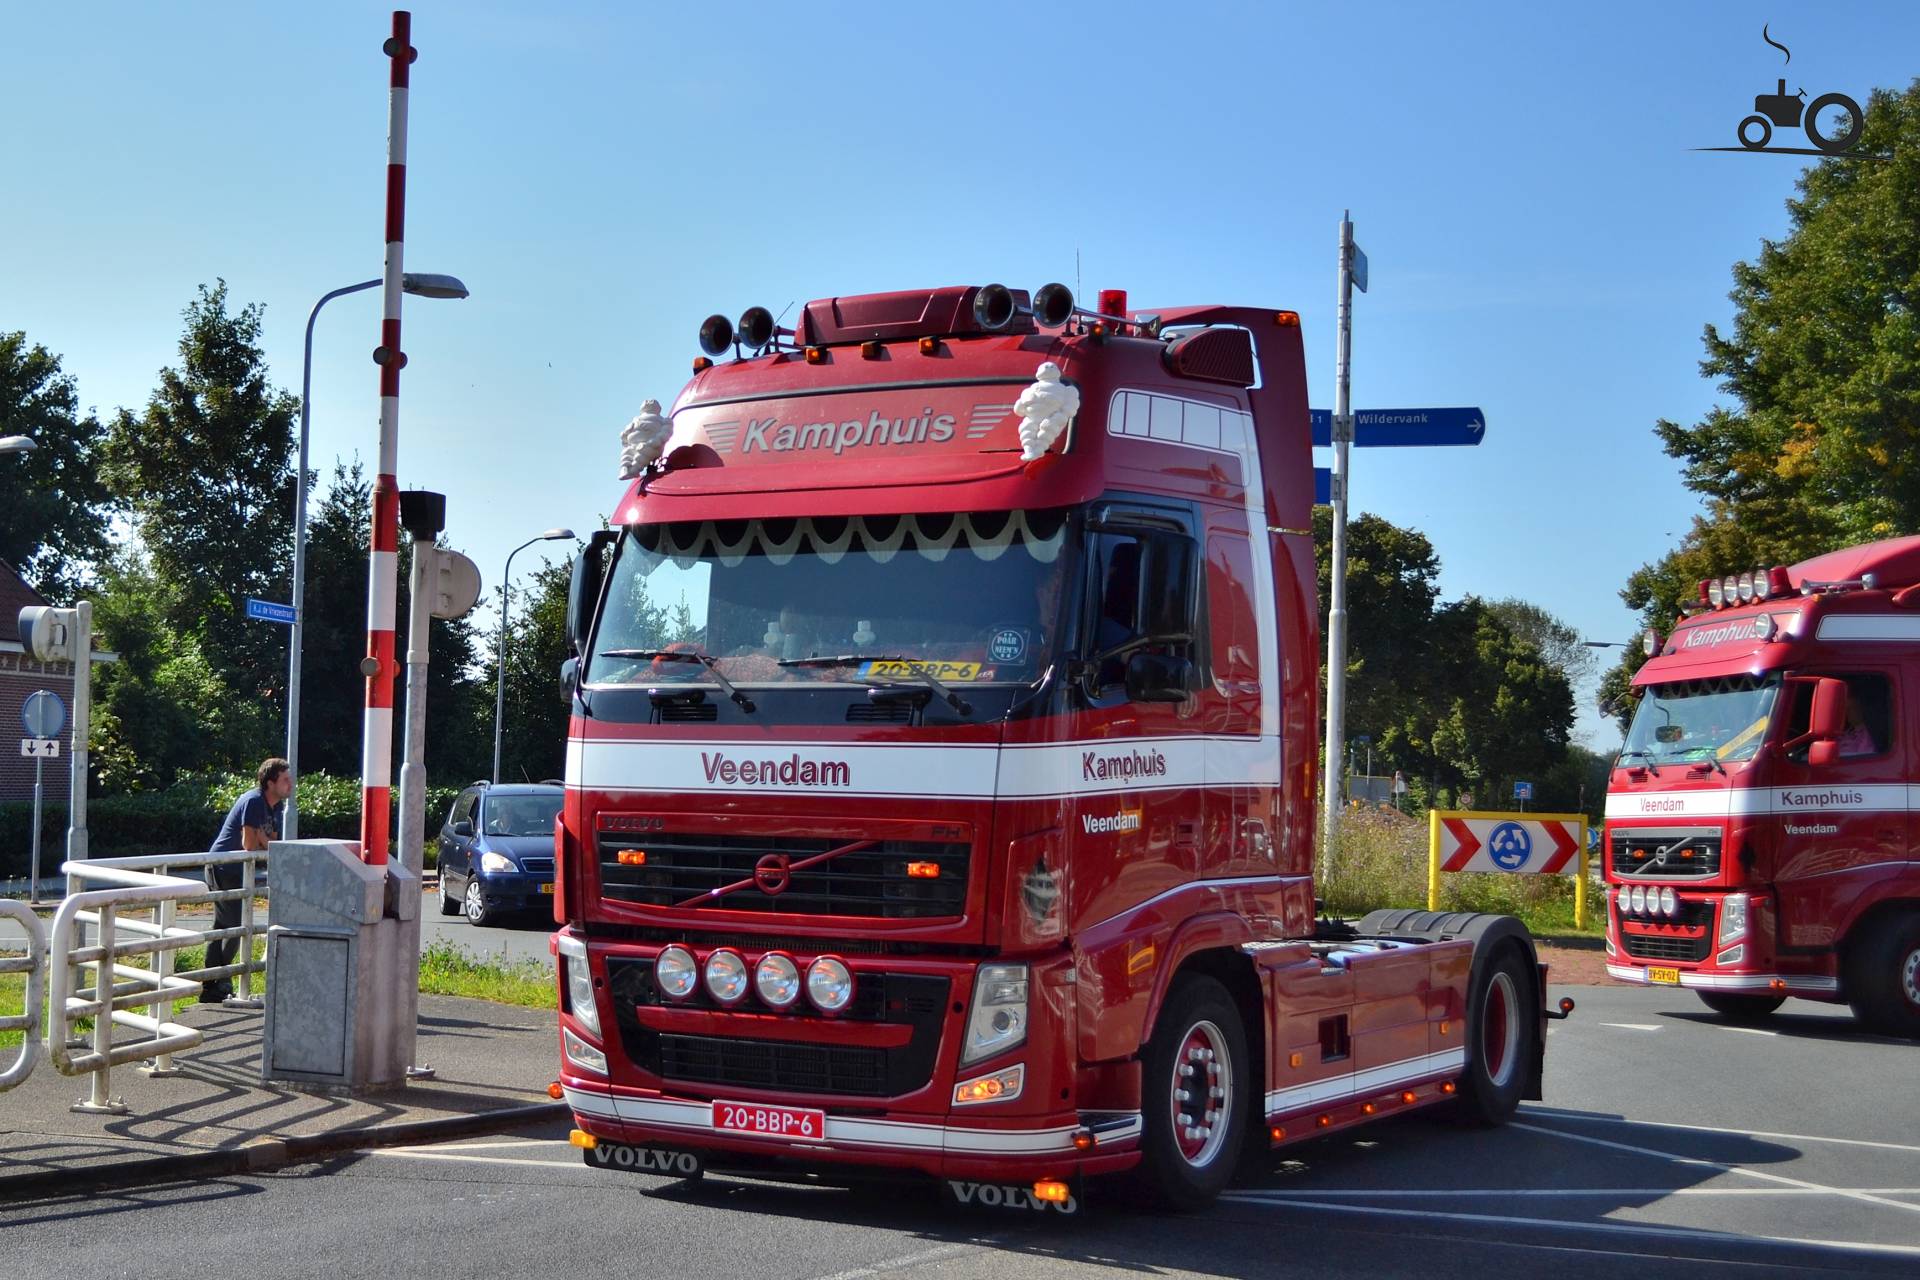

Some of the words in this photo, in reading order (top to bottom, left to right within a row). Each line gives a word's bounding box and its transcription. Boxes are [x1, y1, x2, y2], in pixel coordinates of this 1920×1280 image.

[742, 407, 956, 455] Kamphuis
[1358, 413, 1429, 425] Wildervank
[701, 752, 850, 786] Veendam
[1082, 748, 1166, 784] Kamphuis
[1640, 797, 1685, 812] Veendam
[1781, 789, 1863, 807] Kamphuis
[1082, 811, 1139, 834] Veendam
[1784, 824, 1837, 834] Veendam
[723, 1107, 813, 1135] 20-BBP-6
[593, 1145, 697, 1173] VOLVO
